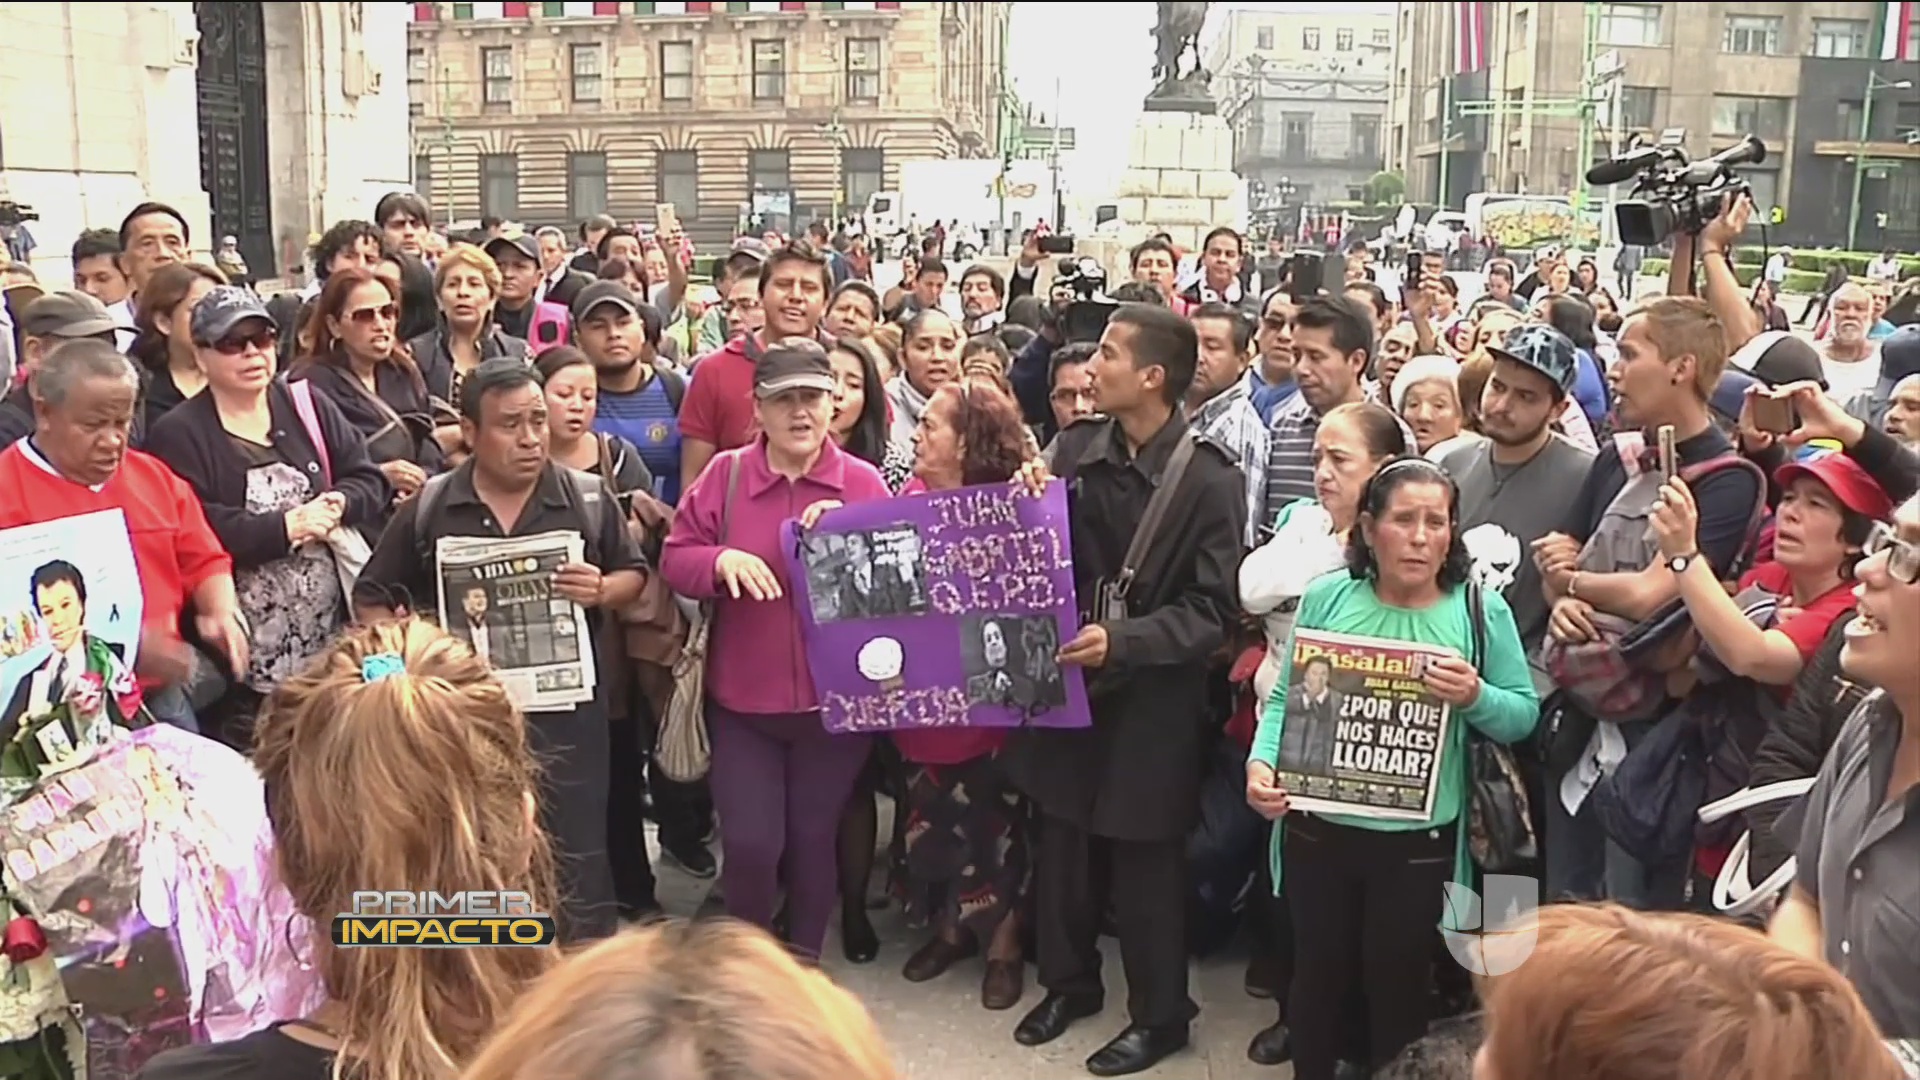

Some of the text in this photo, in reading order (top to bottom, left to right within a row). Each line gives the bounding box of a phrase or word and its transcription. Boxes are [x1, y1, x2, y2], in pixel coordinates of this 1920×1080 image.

[922, 526, 1073, 577] GABRIEL
[1340, 694, 1440, 728] ¿POR QUE
[1336, 720, 1437, 750] NOS HACES
[1332, 741, 1433, 778] LLORAR?
